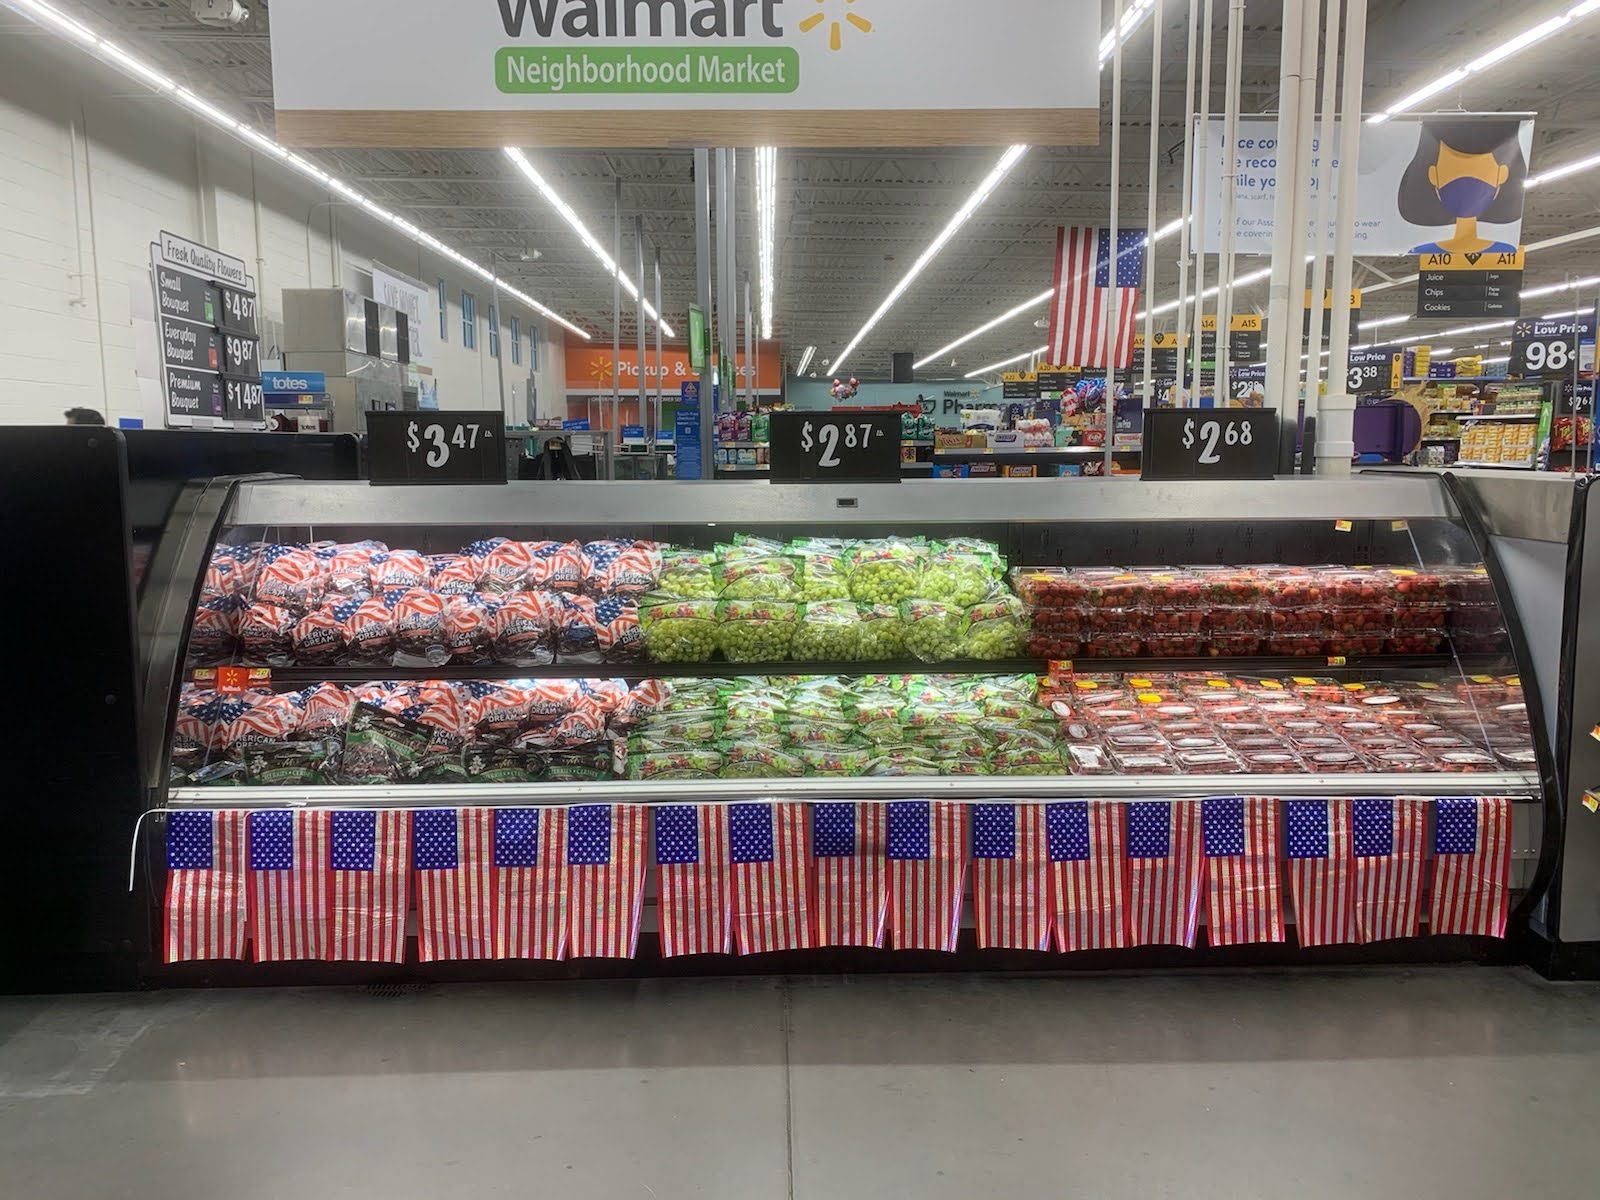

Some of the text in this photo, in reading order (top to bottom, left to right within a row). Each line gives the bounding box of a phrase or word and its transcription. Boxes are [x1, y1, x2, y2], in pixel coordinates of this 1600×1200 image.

[497, 0, 783, 38] Walmart
[506, 54, 786, 91] Neighborhood Market
[167, 240, 242, 281] Fresh Quality Flowers
[1428, 253, 1452, 265] A10
[1497, 253, 1516, 265] A11
[160, 271, 182, 292] Small
[1426, 273, 1444, 281] Juice
[1424, 288, 1444, 298] Chips
[162, 290, 189, 314] Bouquet
[1423, 303, 1451, 311] Cookies
[1241, 319, 1257, 328] A15
[1534, 325, 1558, 335] Low
[165, 322, 197, 347] Everyday
[166, 341, 194, 363] Bouquet
[1350, 353, 1386, 362] Low Price
[617, 361, 669, 380] Pickup
[674, 361, 687, 376] &
[169, 372, 201, 392] Premium
[271, 377, 308, 390] totes
[943, 390, 970, 398] Walmart
[171, 391, 199, 413] Bouquet
[304, 635, 335, 648] DREAM
[358, 630, 389, 641] DREAM
[488, 714, 518, 722] DREAM
